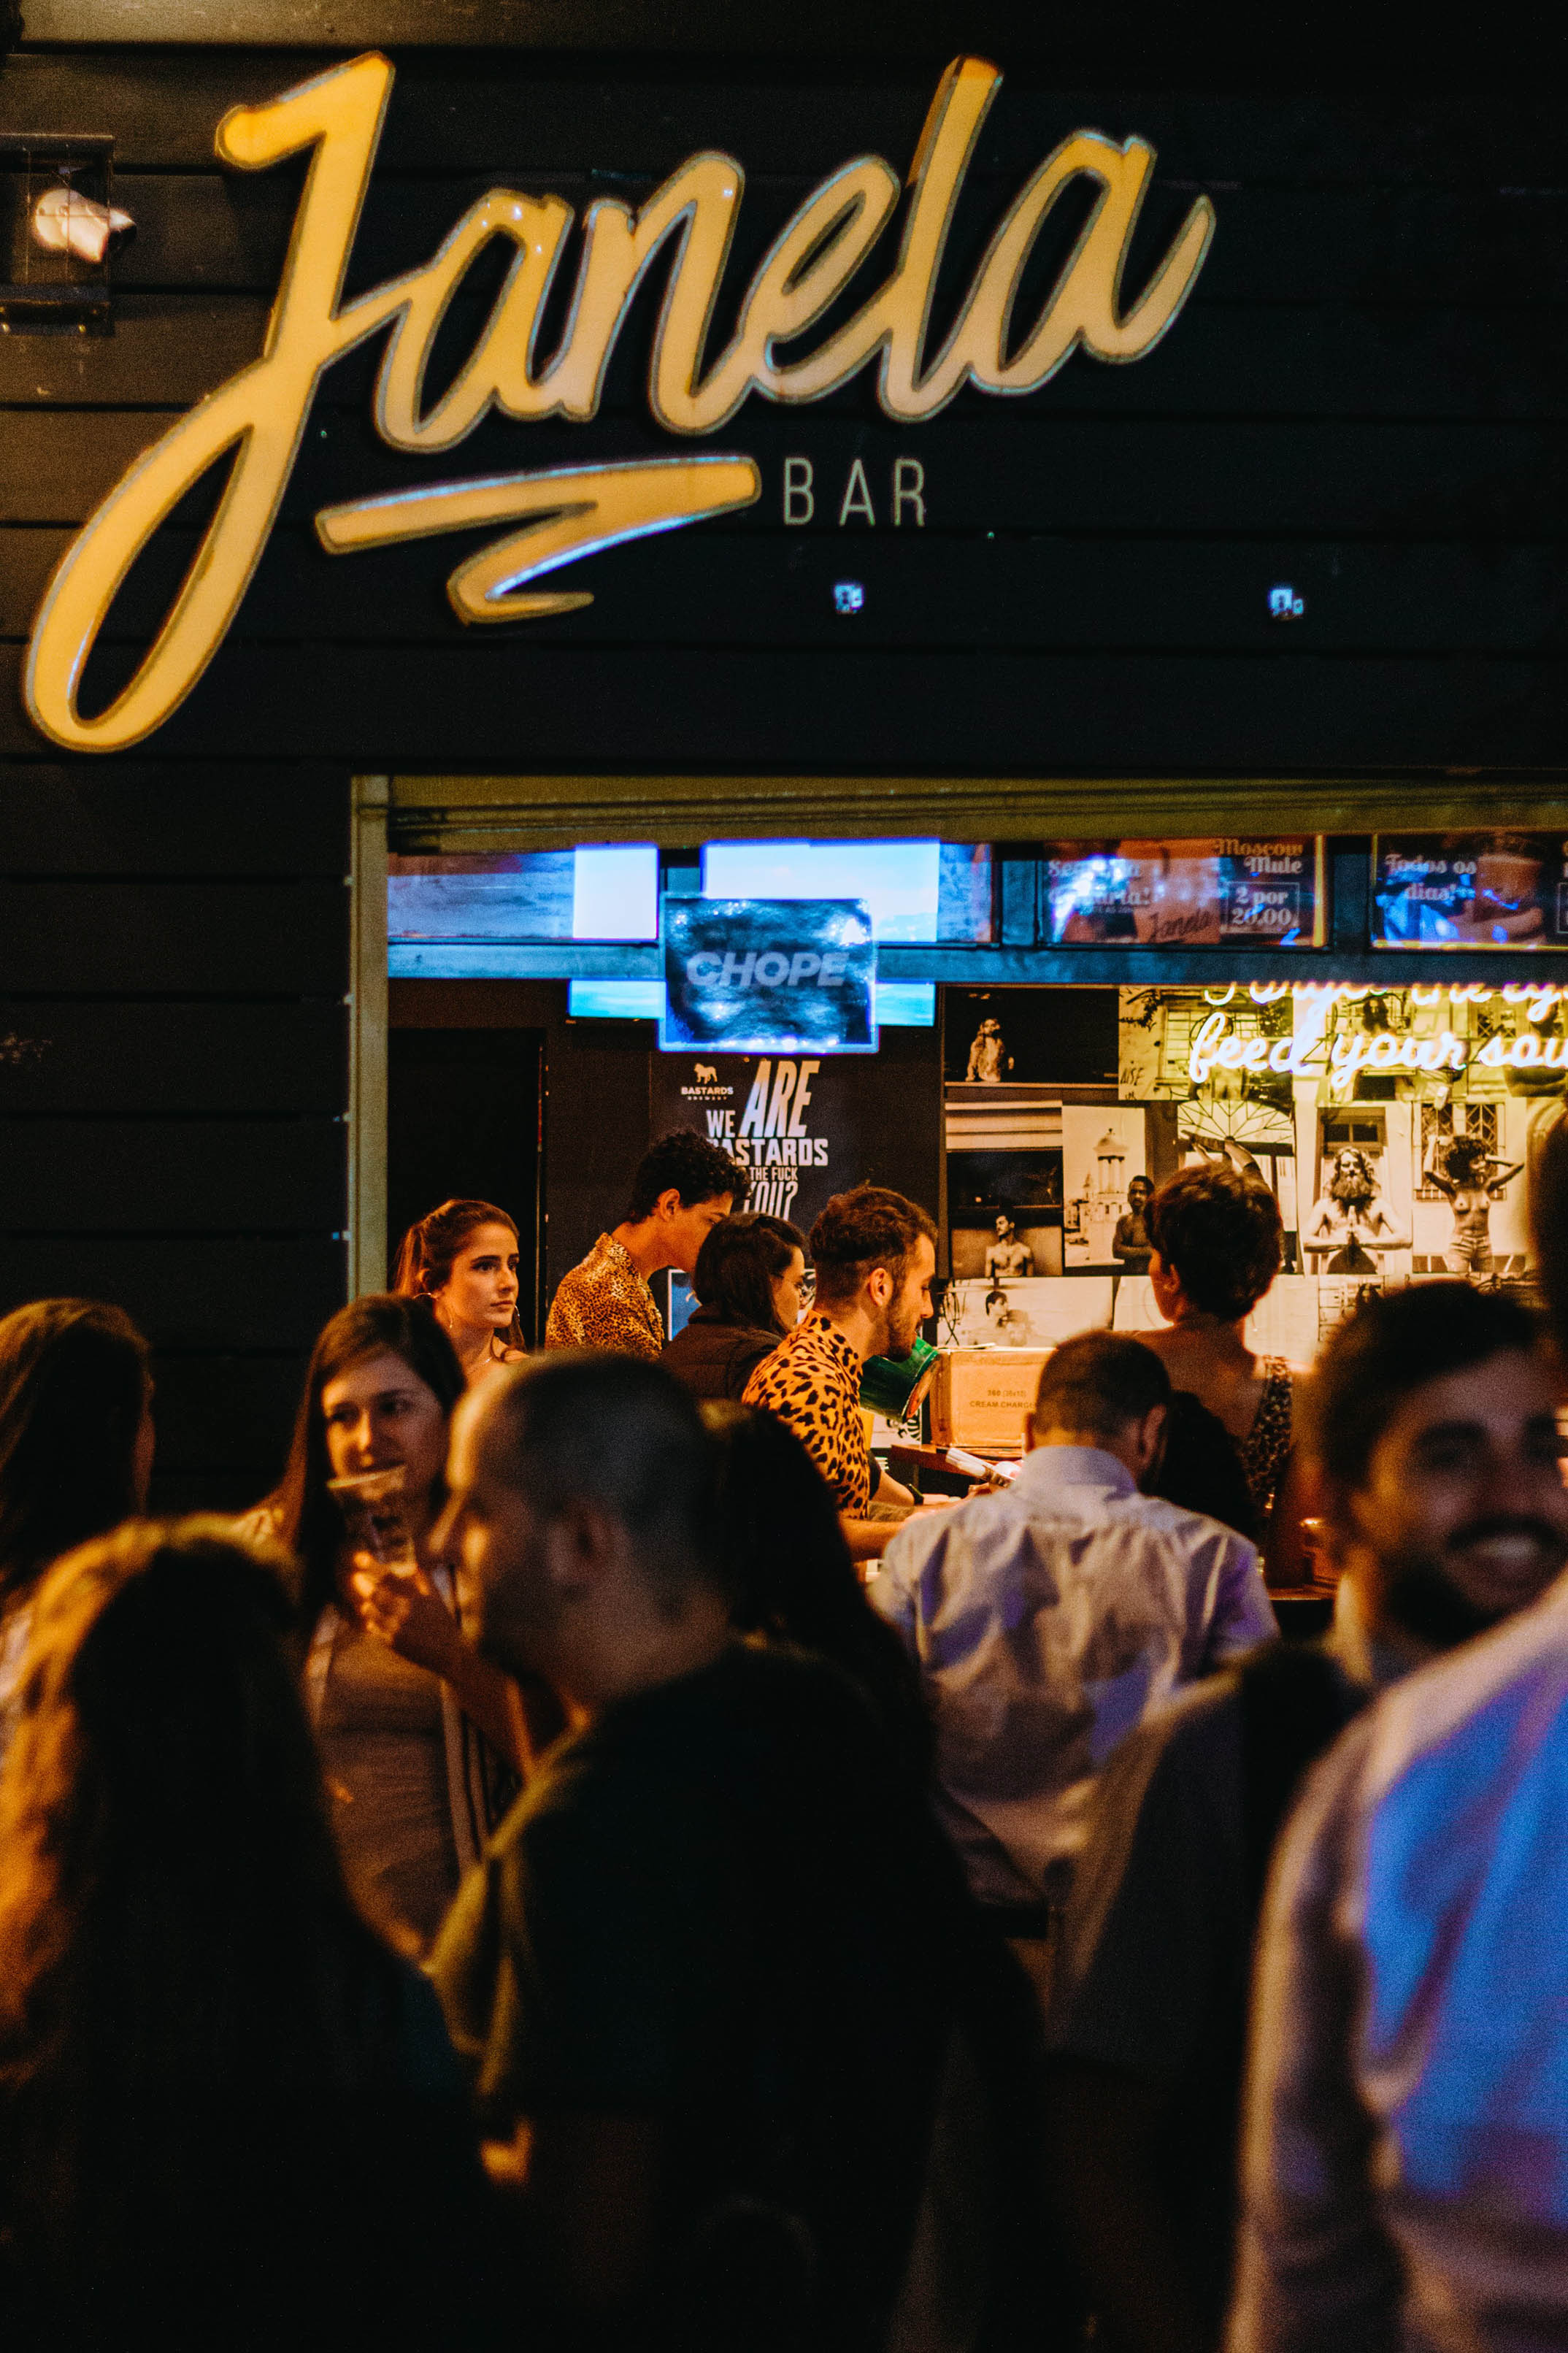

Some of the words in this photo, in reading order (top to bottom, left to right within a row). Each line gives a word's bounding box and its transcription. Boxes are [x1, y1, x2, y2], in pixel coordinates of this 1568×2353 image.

[23, 50, 1218, 752] Janela
[783, 457, 926, 526] BAR
[1213, 839, 1303, 856] Moscow
[1243, 856, 1302, 875] Mule
[1453, 861, 1477, 874] os
[1237, 886, 1249, 905] 2
[1253, 891, 1289, 910] por
[686, 951, 850, 987] CHOPE
[1189, 1012, 1314, 1083] feed
[1331, 1031, 1467, 1087] your
[1477, 1032, 1568, 1068] sou
[680, 1086, 734, 1096] BASTARDS
[707, 1109, 736, 1138] WE
[738, 1060, 820, 1138] ARE
[750, 1167, 769, 1181] THE
[771, 1167, 799, 1181] FUCK
